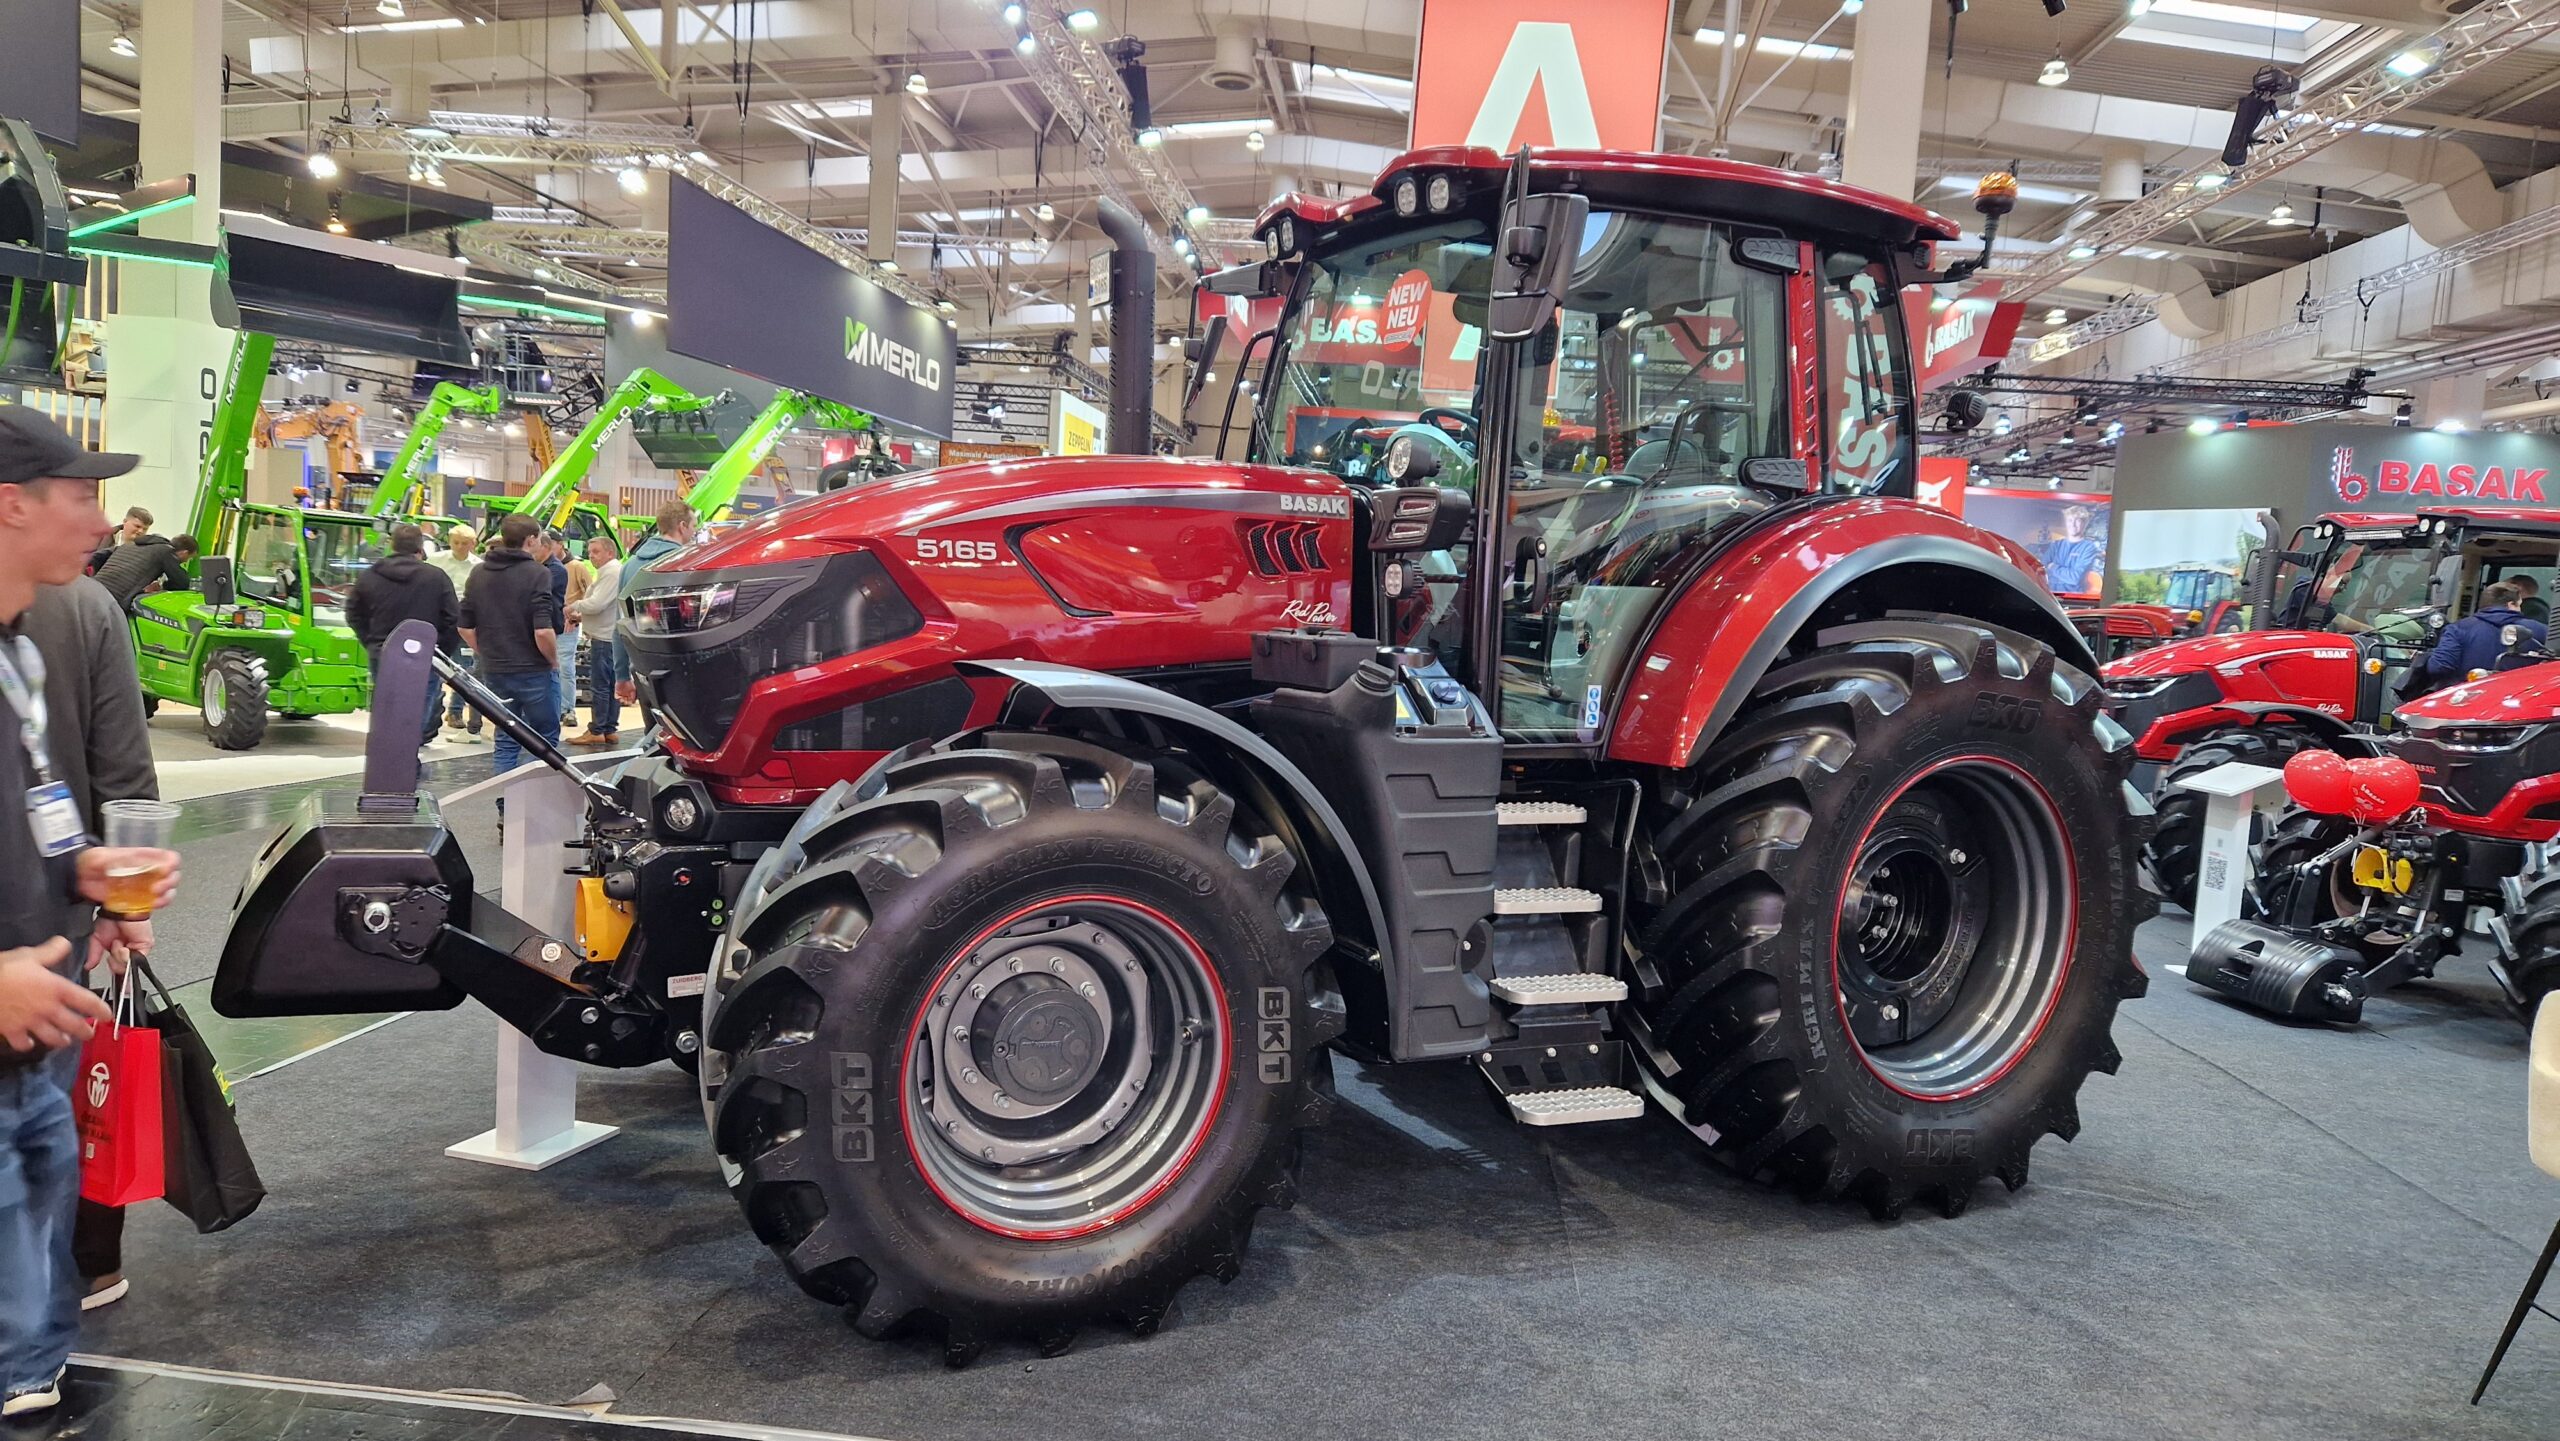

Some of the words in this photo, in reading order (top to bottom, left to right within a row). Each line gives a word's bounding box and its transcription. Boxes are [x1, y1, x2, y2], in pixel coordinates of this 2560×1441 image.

[1388, 280, 1429, 307] NEW
[1386, 304, 1420, 330] NEU
[1933, 309, 1977, 353] BASAK
[870, 331, 940, 392] MERLO
[591, 405, 632, 453] MERLO
[1068, 430, 1092, 455] ZEPPELIN
[402, 435, 433, 480] MERLO
[2378, 460, 2549, 502] BASAK
[1280, 495, 1346, 514] BASAK
[917, 538, 997, 560] 5165
[1280, 599, 1310, 624] Red
[1306, 601, 1337, 623] Power
[2313, 649, 2349, 659] BASAK
[1260, 989, 1288, 1082] BKT
[835, 1054, 871, 1160] BKT
